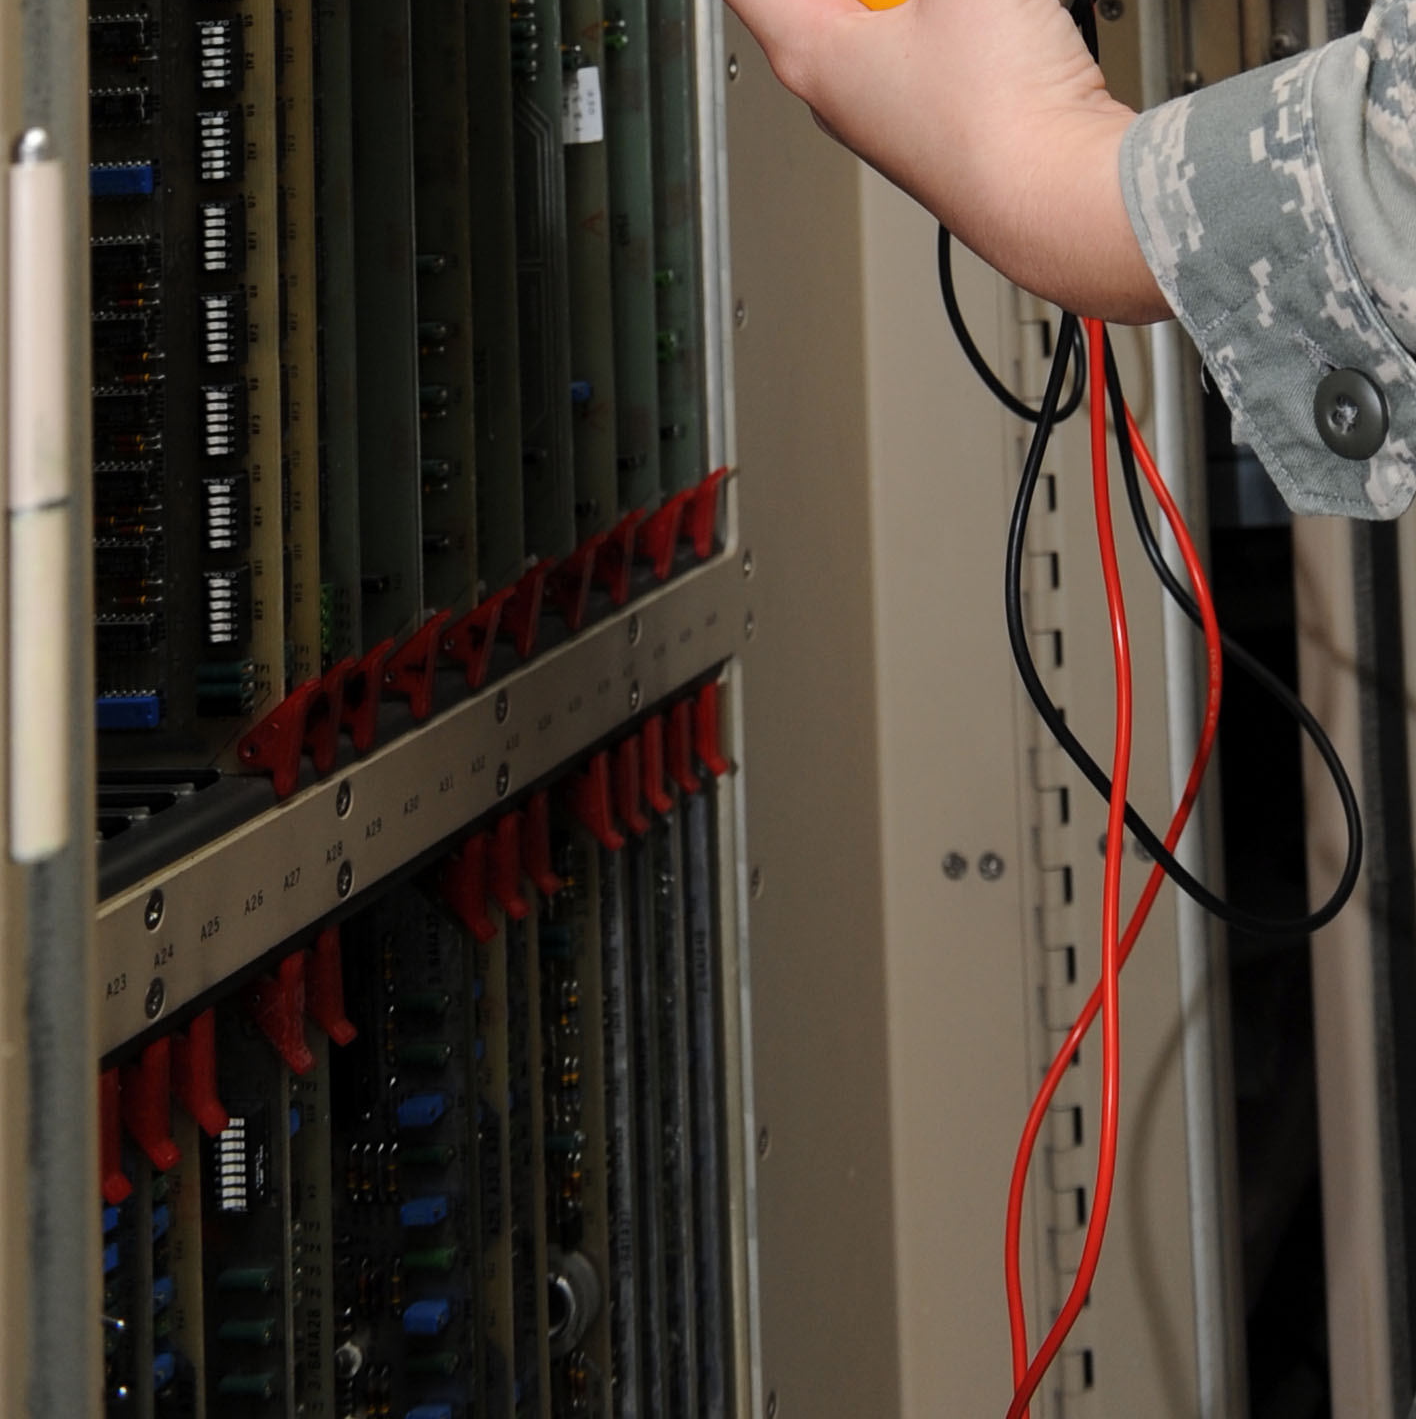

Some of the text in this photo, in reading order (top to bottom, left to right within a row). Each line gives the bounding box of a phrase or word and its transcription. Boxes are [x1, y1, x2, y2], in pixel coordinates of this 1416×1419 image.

[106, 973, 127, 1000] A23
[153, 943, 174, 970] A24
[200, 916, 220, 943] A25
[244, 889, 264, 915] A26
[282, 866, 301, 892] A27
[325, 840, 343, 864] A28
[365, 816, 382, 839] A29
